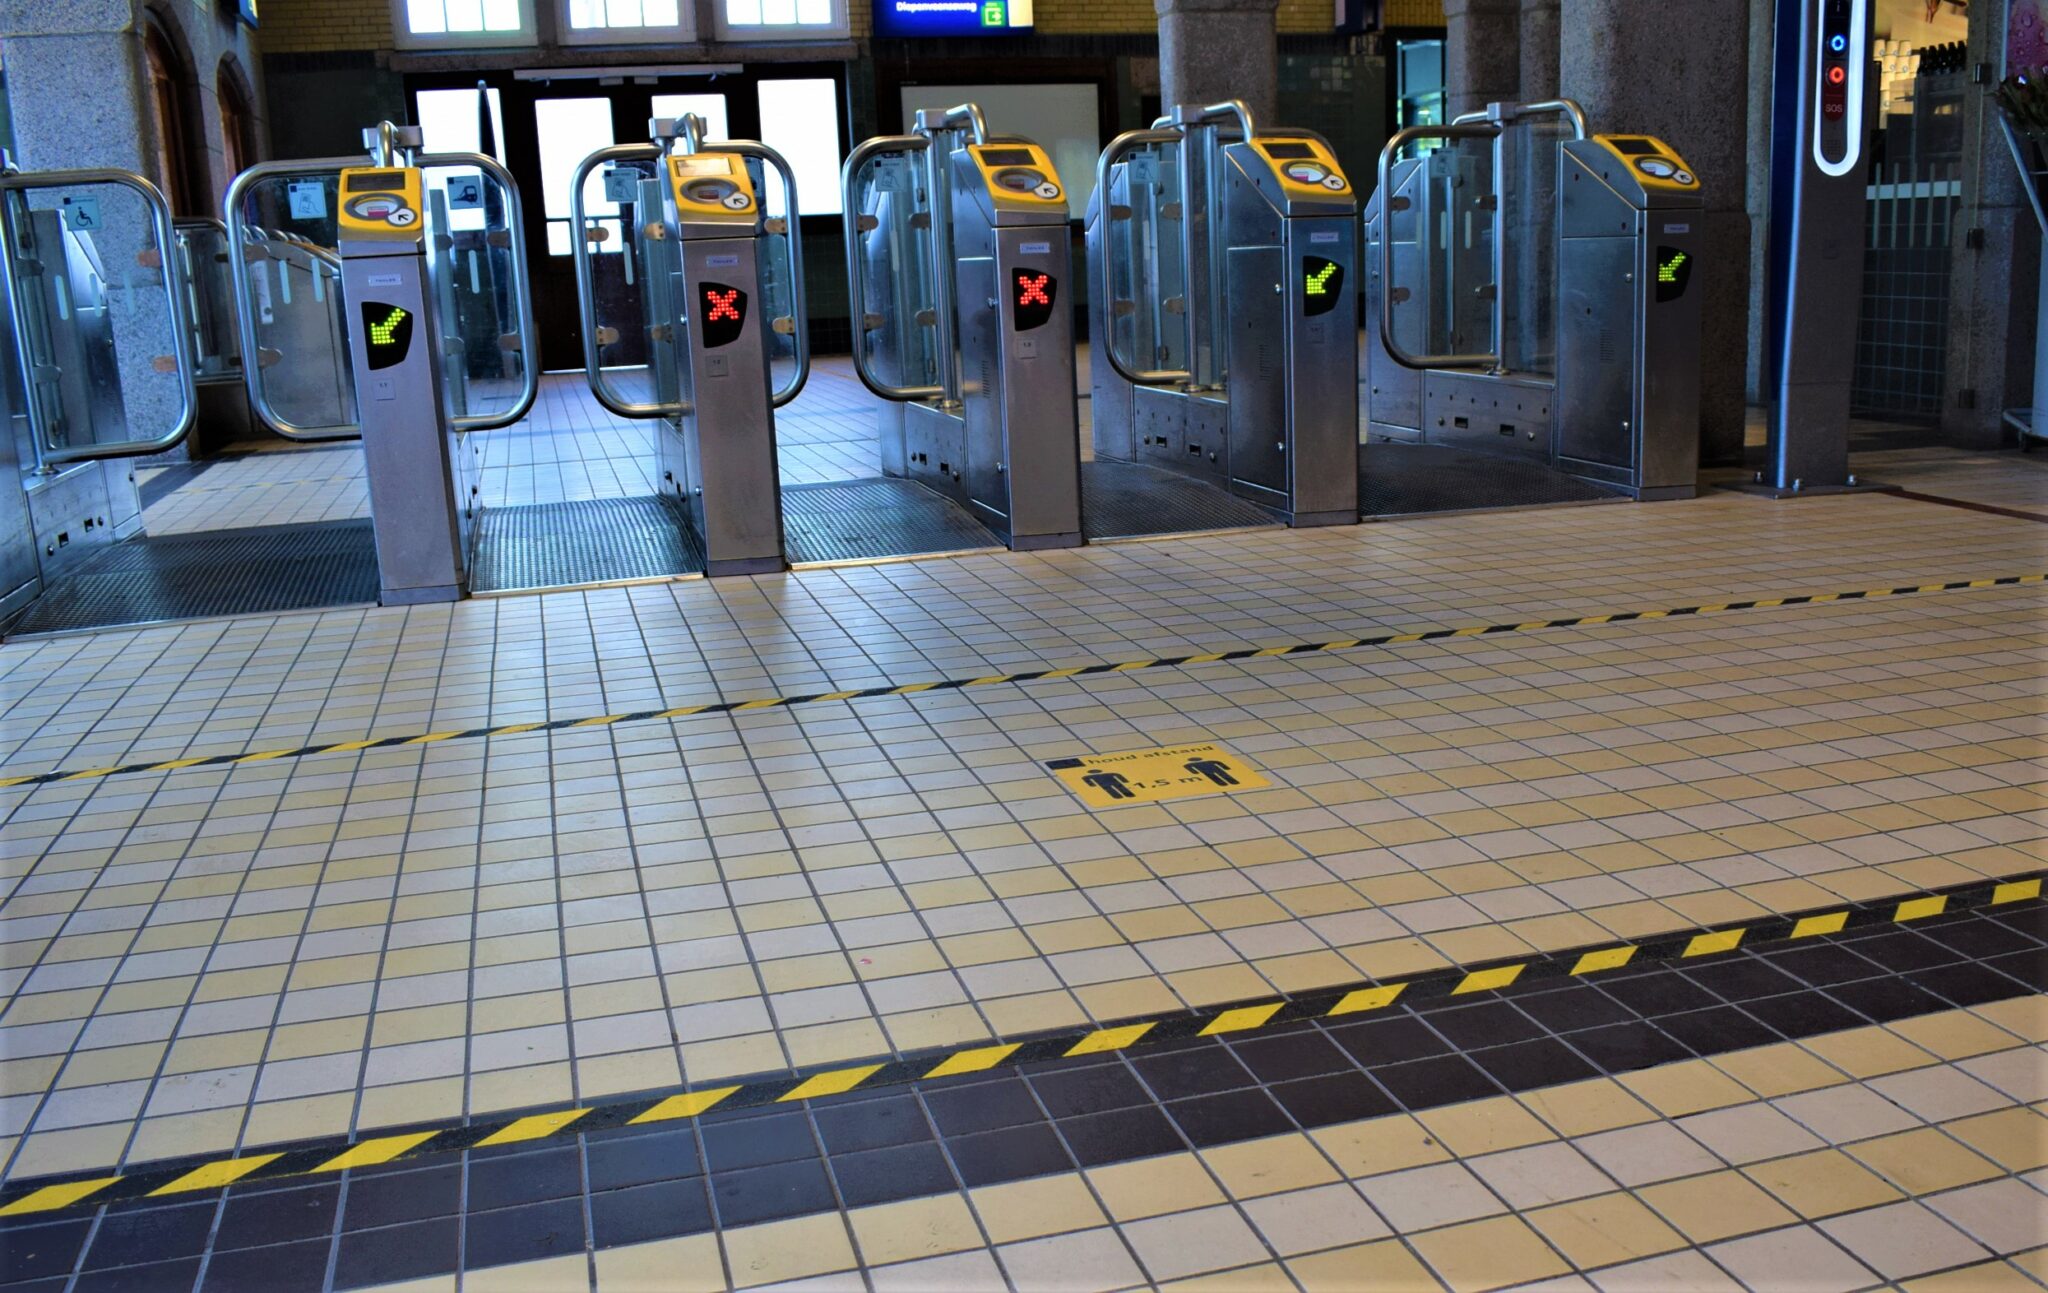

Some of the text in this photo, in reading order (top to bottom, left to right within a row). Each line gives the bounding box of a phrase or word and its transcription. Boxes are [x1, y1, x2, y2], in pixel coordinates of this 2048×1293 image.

[1825, 103, 1843, 113] SOS
[1087, 745, 1215, 765] houd afstand
[1178, 775, 1203, 784] m
